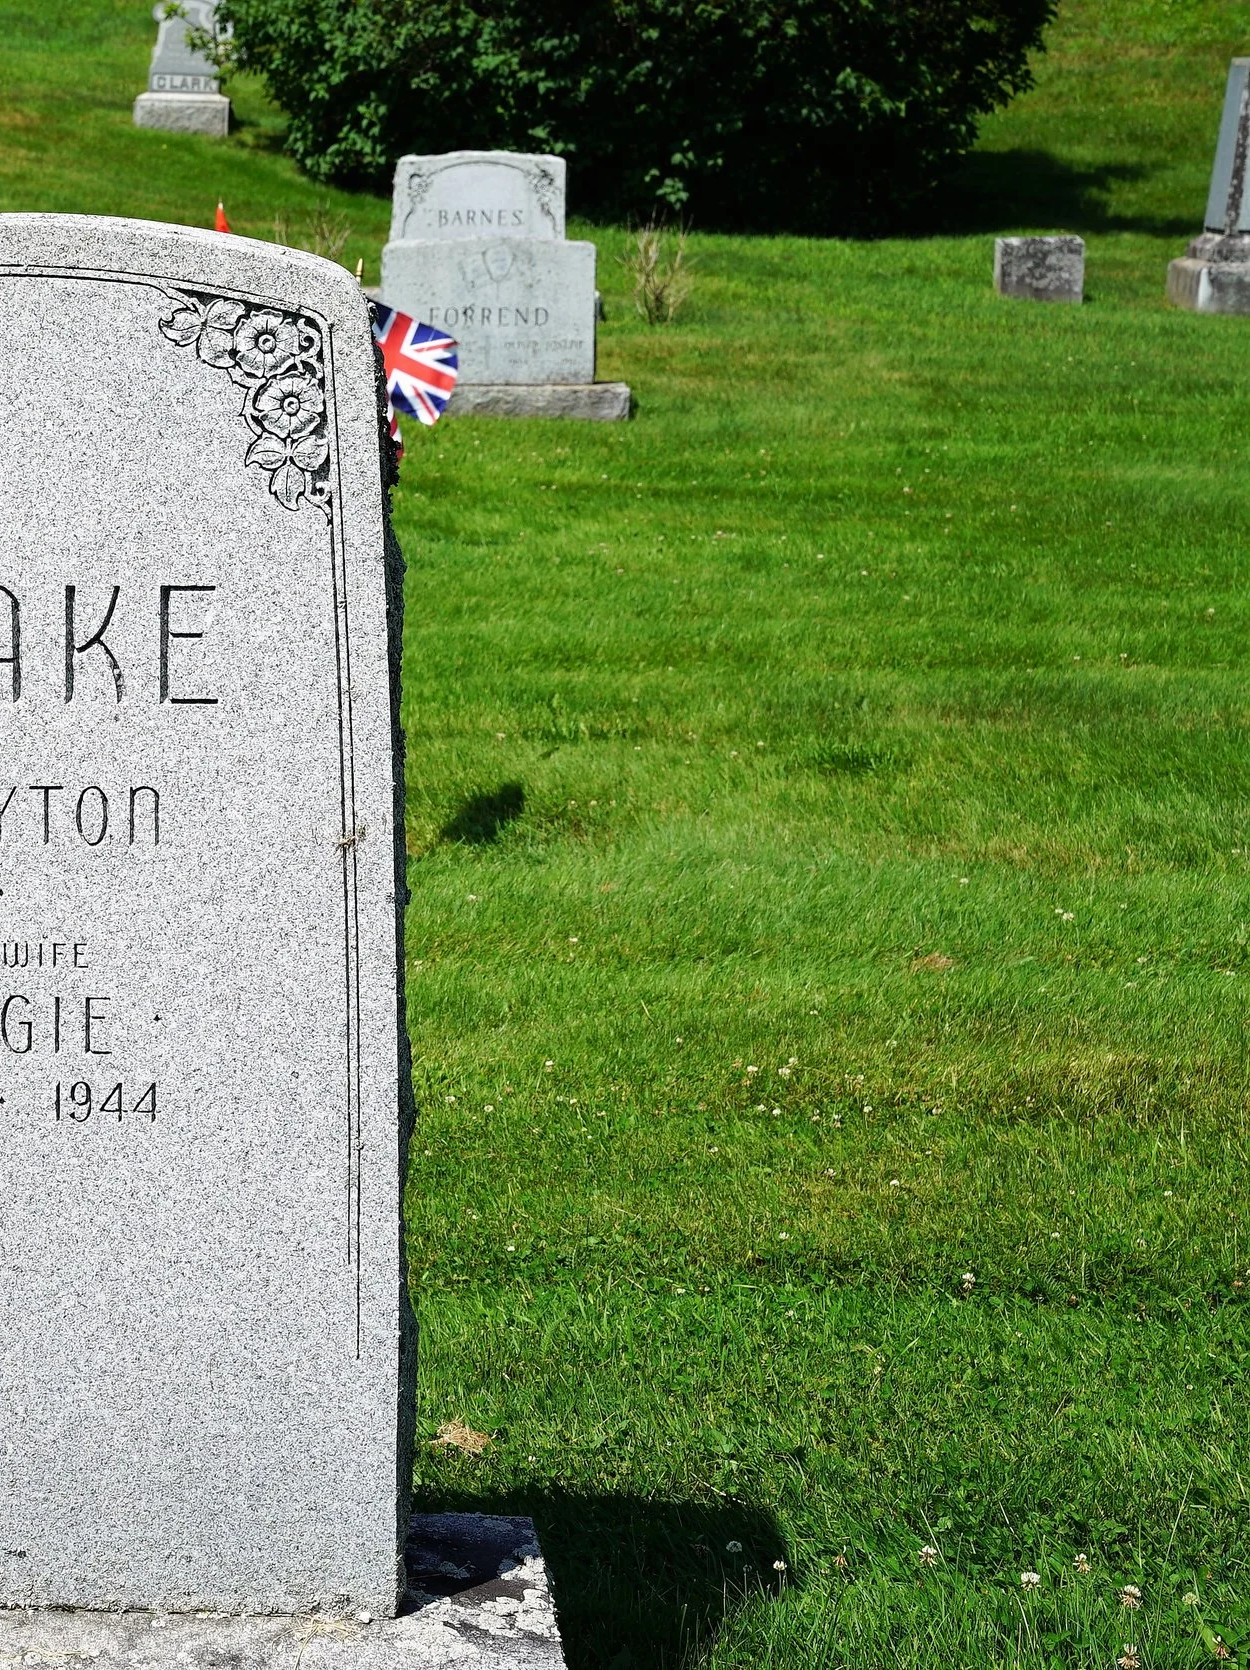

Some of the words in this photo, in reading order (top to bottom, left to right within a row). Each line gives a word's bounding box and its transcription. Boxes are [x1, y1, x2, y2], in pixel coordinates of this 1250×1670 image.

[157, 76, 215, 91] CLARK
[438, 209, 524, 228] BARNES
[2, 941, 89, 968] WIFE
[54, 1081, 162, 1123] 1944
